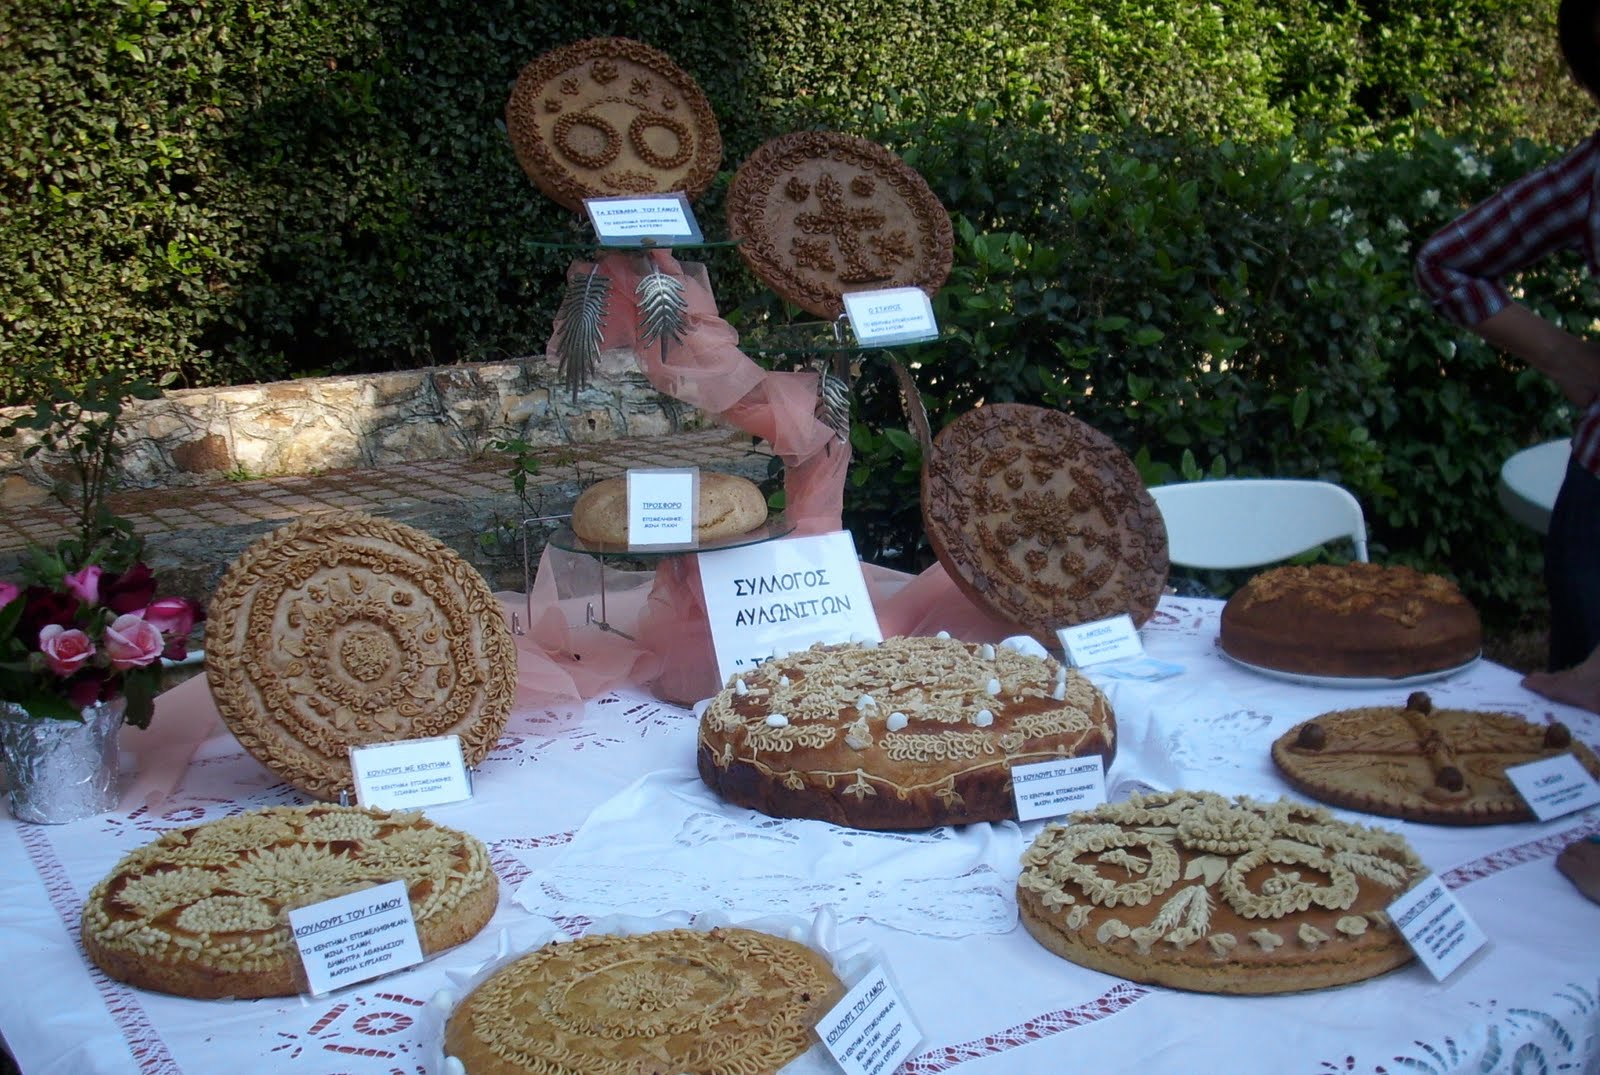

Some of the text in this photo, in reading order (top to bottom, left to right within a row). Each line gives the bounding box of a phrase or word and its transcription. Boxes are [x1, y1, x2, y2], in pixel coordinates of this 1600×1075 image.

[734, 570, 830, 596] ΣΥΛΛΟΓΟΣ
[736, 595, 851, 627] ΑΥΛΩΝΙΤΩΝ
[367, 767, 402, 777] ΚΟΥΛΟΥΡΙ
[417, 761, 451, 770] ΚΕΝΤΗΜΑ
[1024, 770, 1052, 781] ΚΟΥΛΟΥΡΙ
[1054, 768, 1066, 776] ΤΟΥ
[1070, 764, 1098, 773] ΓΑΜΠΡΟΥ
[295, 898, 402, 937] ΚΟΥΛΟΥΡΙ ΤΟΥ ΓΑΜΟΥ
[301, 946, 312, 956] ΤΟ
[314, 936, 348, 952] ΚΕΝΤΗΜΑ
[324, 940, 371, 960] ΜΙΝΑ ΤΣΑΜΗ
[328, 939, 405, 969] ΔΗΜΗΤΡΑ ΑΘΑΝΑΣΙΟΥ
[330, 953, 392, 978] ΜΑΡΙΝΑ ΚΥΡΙΑΚΟΥ
[826, 978, 886, 1044] ΚΟΥΛΟΥΡΙ ΤΟΥ ΓΑΜΟΥ
[839, 1055, 847, 1064] ΤΟ
[846, 1034, 865, 1057] ΚΕΝΤΗΜΑ
